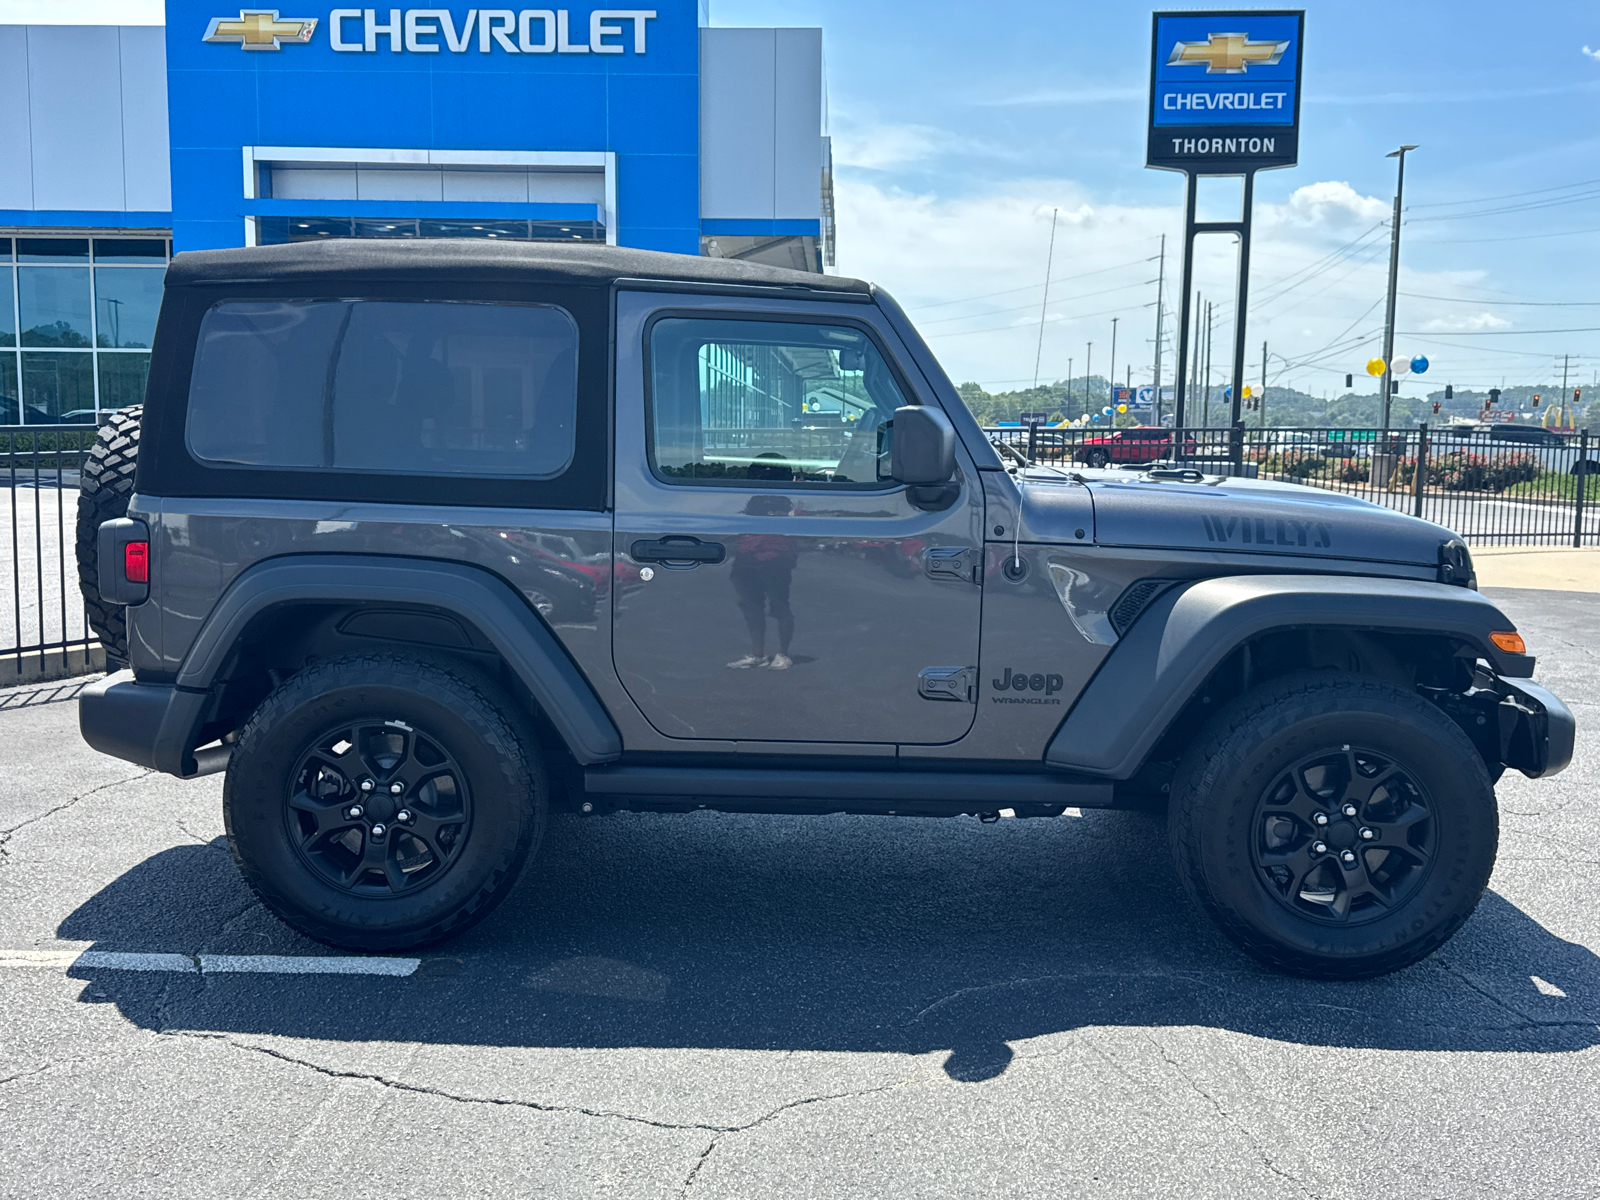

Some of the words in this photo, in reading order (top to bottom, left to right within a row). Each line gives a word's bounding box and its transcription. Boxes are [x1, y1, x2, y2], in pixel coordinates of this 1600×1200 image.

[329, 8, 657, 54] CHEVROLET
[1163, 92, 1287, 110] CHEVROLET
[1172, 137, 1275, 154] THORNTON
[1200, 514, 1333, 548] WILLYS
[992, 667, 1064, 696] Jeep
[991, 696, 1061, 705] WRANGLER
